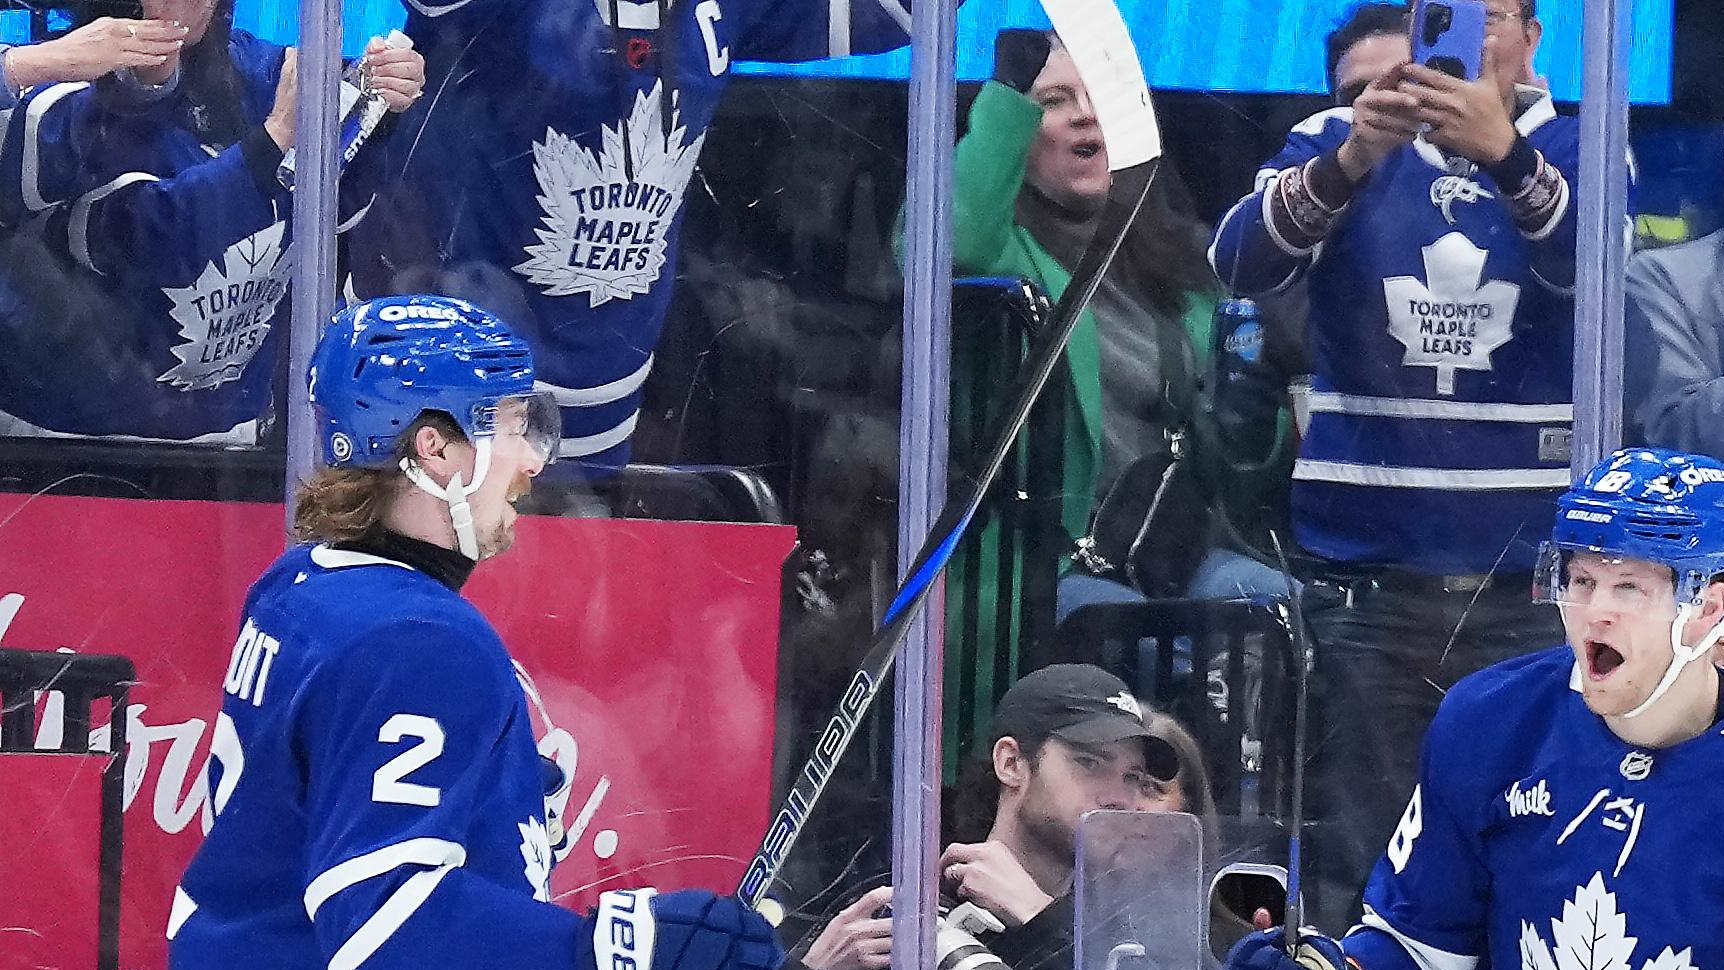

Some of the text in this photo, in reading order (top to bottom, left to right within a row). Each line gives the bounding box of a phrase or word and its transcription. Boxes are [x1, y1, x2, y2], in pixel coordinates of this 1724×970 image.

[694, 0, 729, 76] C
[570, 182, 673, 217] TORONTO
[574, 216, 660, 245] MAPLE
[568, 243, 651, 272] LEAFS
[190, 278, 282, 321] TORONTO
[1409, 300, 1493, 320] TORONTO
[207, 304, 265, 341] MAPLE
[1419, 318, 1477, 338] MAPLE
[201, 329, 258, 364] LEAFS
[1422, 337, 1473, 356] LEAFS
[223, 617, 280, 707] OIT
[372, 714, 445, 806] 2
[1505, 779, 1556, 818] Milk
